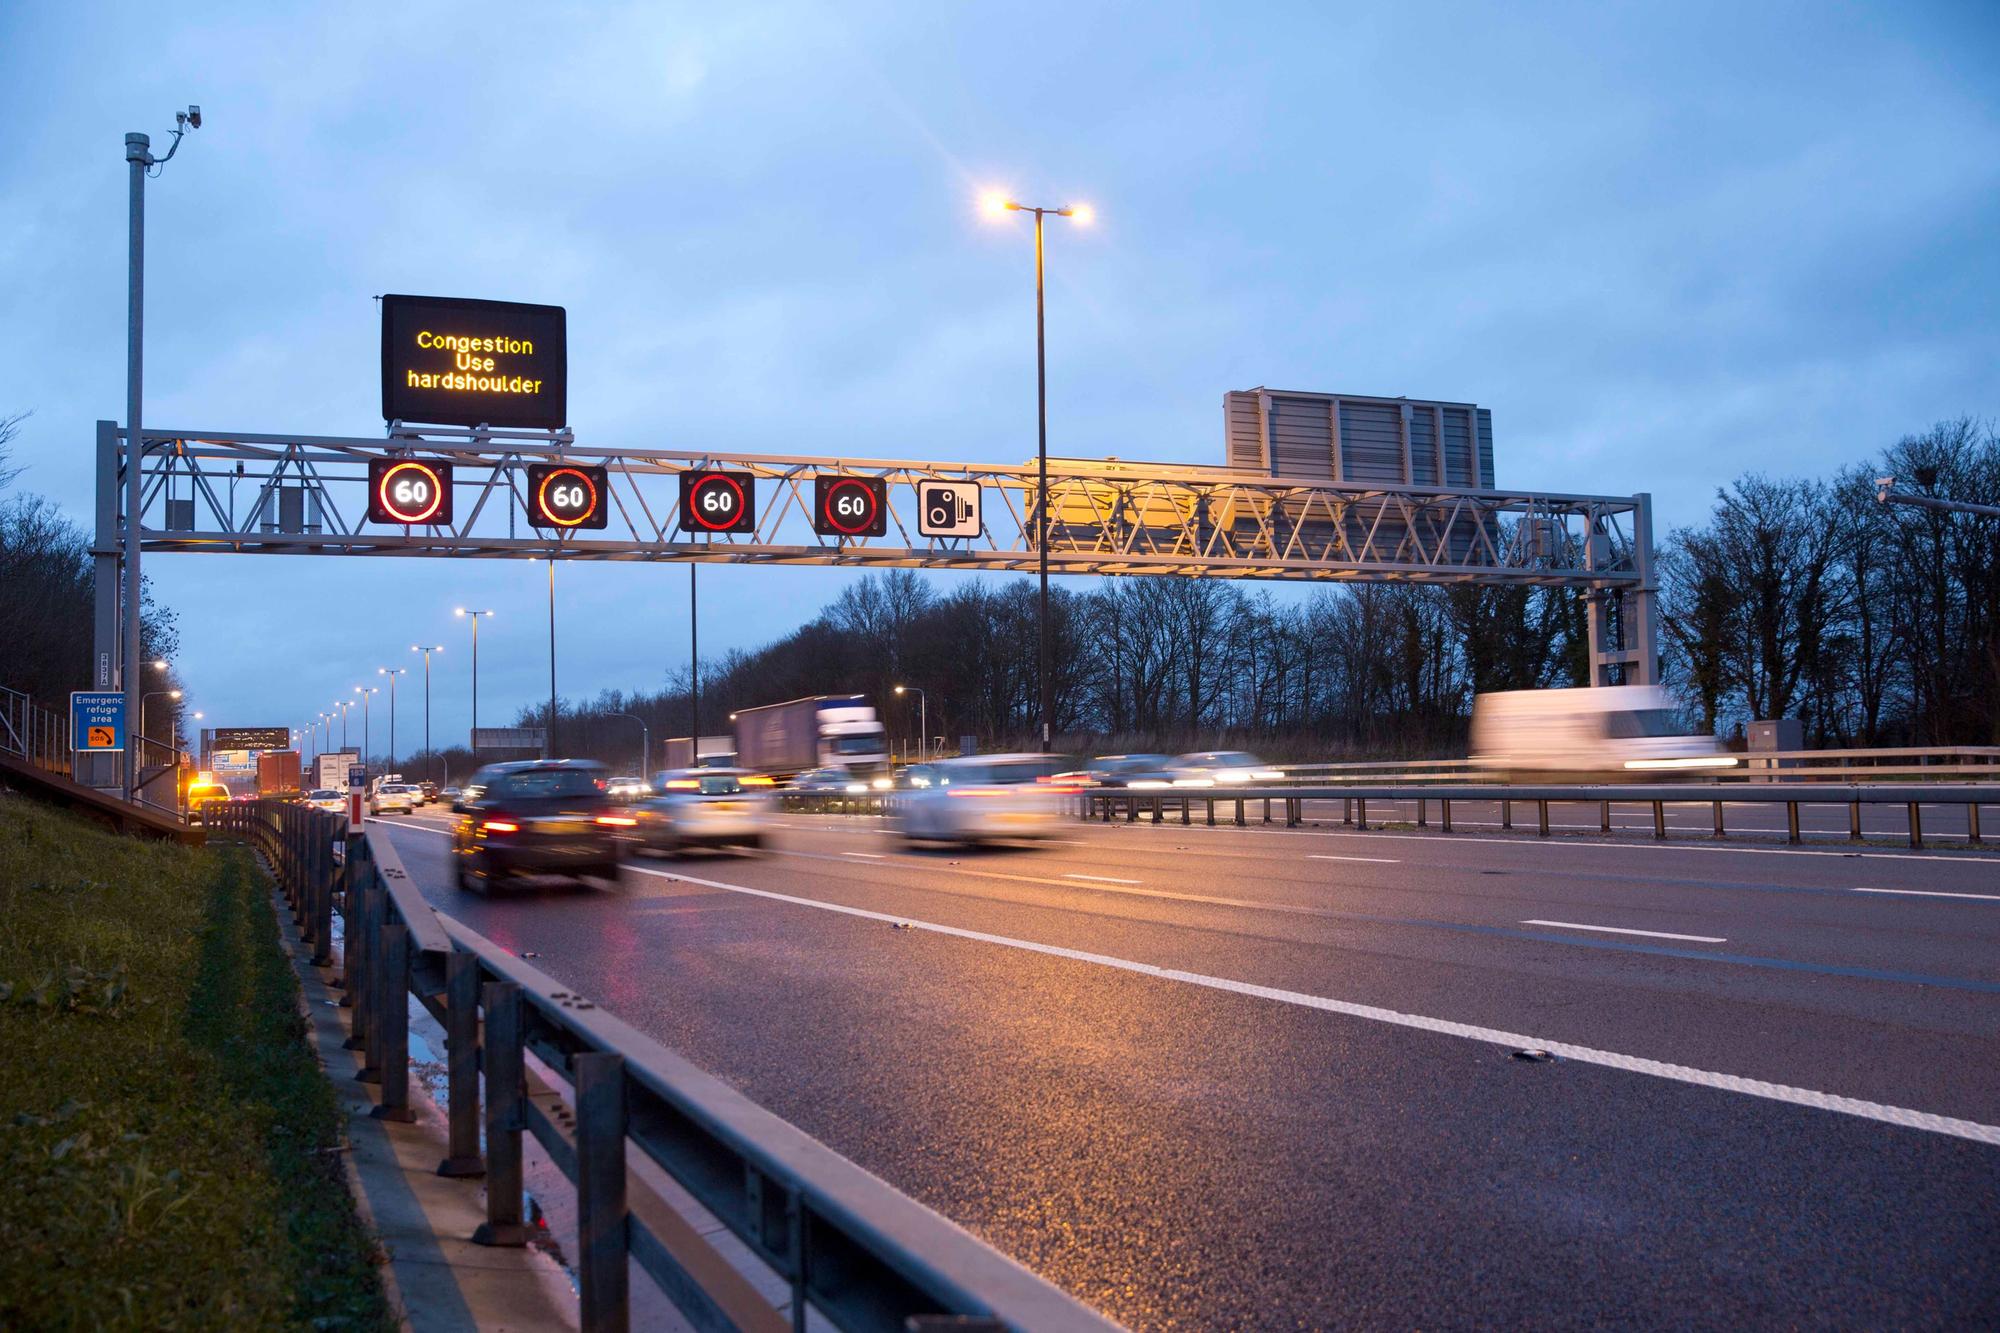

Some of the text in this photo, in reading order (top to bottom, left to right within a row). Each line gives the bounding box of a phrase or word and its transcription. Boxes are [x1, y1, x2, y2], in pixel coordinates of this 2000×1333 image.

[417, 331, 533, 355] Congestion
[456, 353, 495, 372] Use
[407, 369, 542, 394] hardshoulder
[395, 480, 428, 503] 60
[552, 486, 584, 507] 60
[703, 491, 732, 512] 60
[837, 496, 865, 516] 60
[76, 696, 124, 706] Emergenc
[86, 705, 118, 715] refuge
